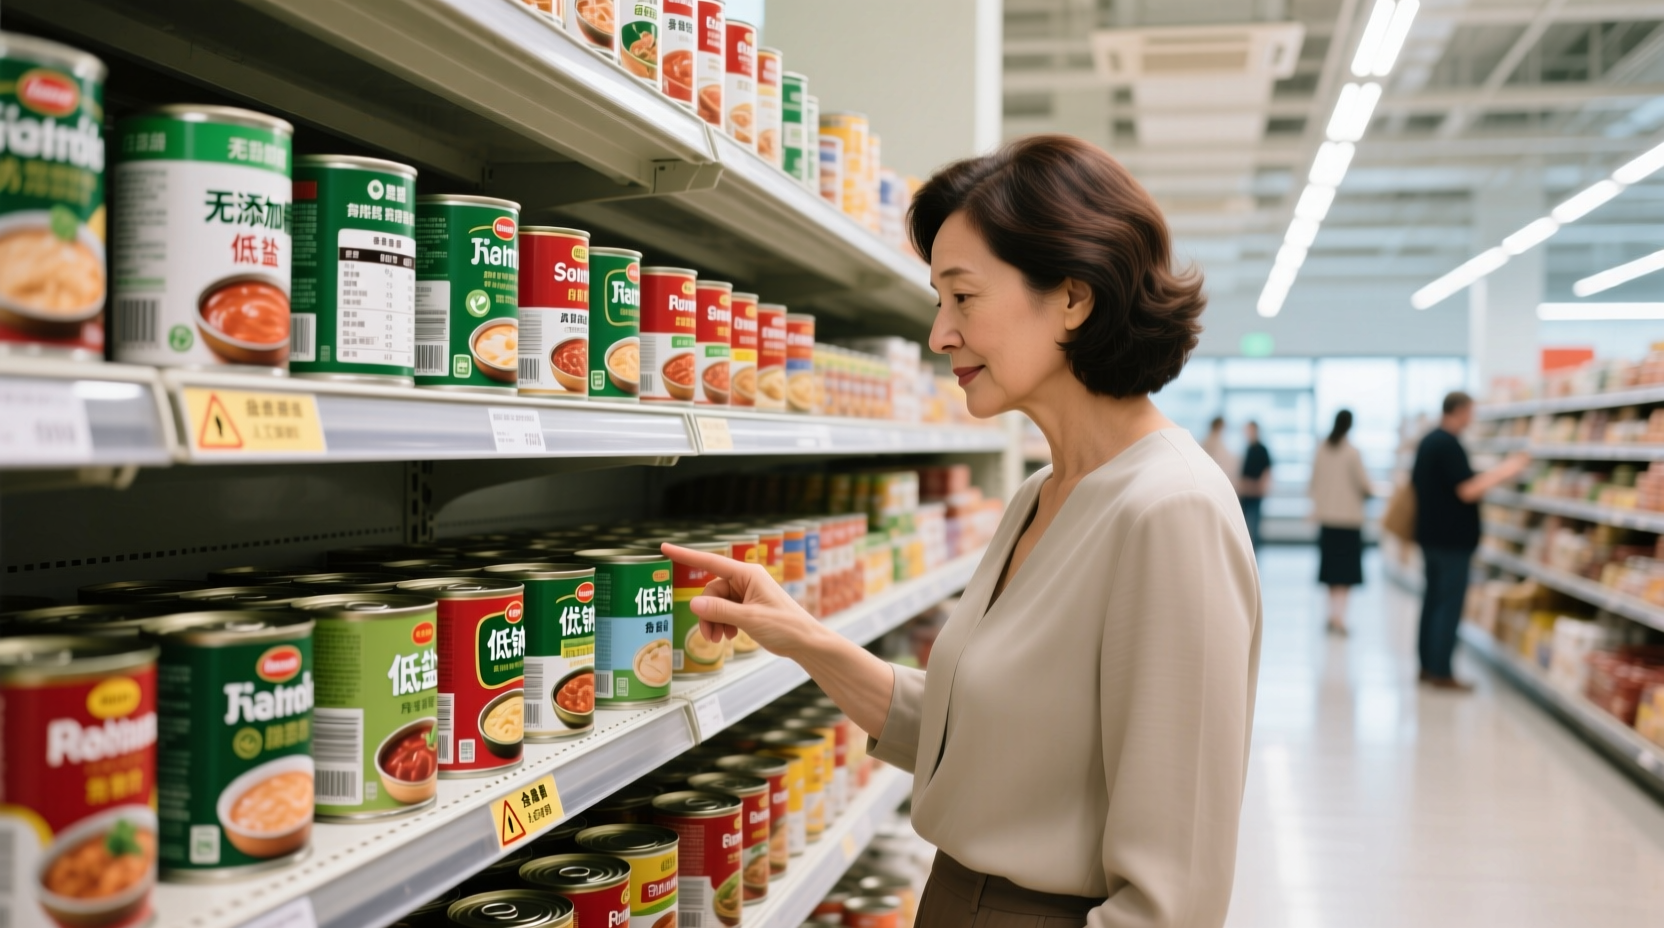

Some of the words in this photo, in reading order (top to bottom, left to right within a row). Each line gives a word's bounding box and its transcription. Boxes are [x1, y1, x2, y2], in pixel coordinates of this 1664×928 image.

[231, 234, 279, 268] 低盐
[635, 585, 672, 615] 低钠
[487, 625, 524, 661] 低钠
[387, 648, 438, 696] 低盐
